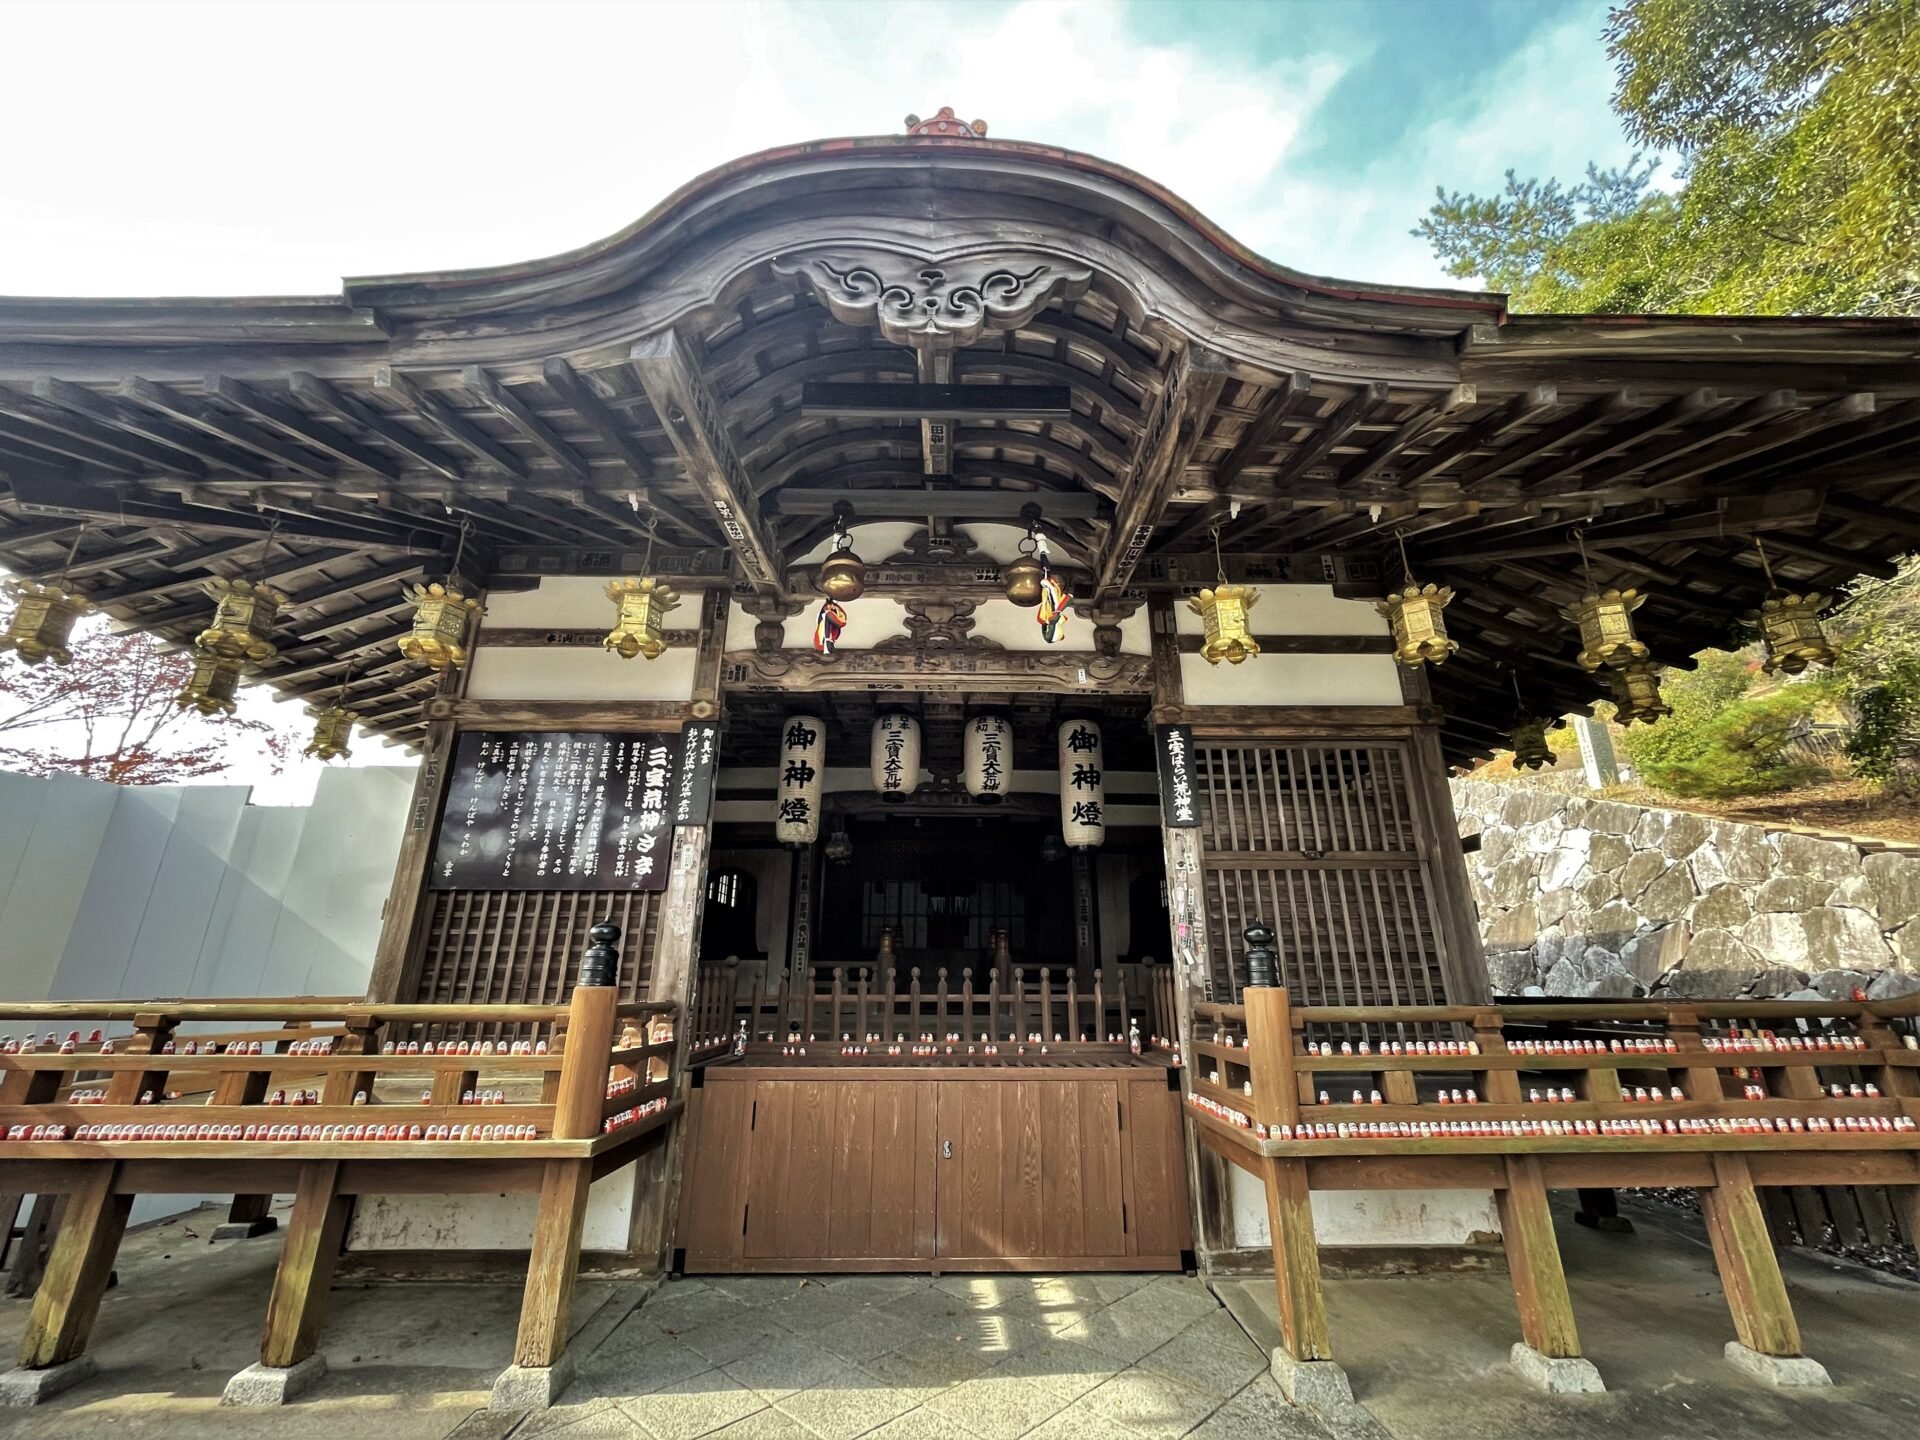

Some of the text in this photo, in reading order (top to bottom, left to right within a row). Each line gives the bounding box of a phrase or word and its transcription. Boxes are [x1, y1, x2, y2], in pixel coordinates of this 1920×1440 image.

[899, 716, 911, 730] 日本
[994, 717, 1007, 734] 日本
[491, 741, 502, 763] ご真言
[599, 741, 612, 780] 千三百年前、
[615, 742, 625, 774] さまです。
[701, 728, 714, 764] 御真言
[779, 722, 816, 824] 御神燈
[1067, 725, 1102, 826] 御神燈
[1167, 731, 1193, 821] 三宝はらい荒神堂
[459, 741, 489, 855] おん けんばや けんばや そわか
[634, 746, 668, 875] 三宝荒神さま
[553, 858, 562, 873] その
